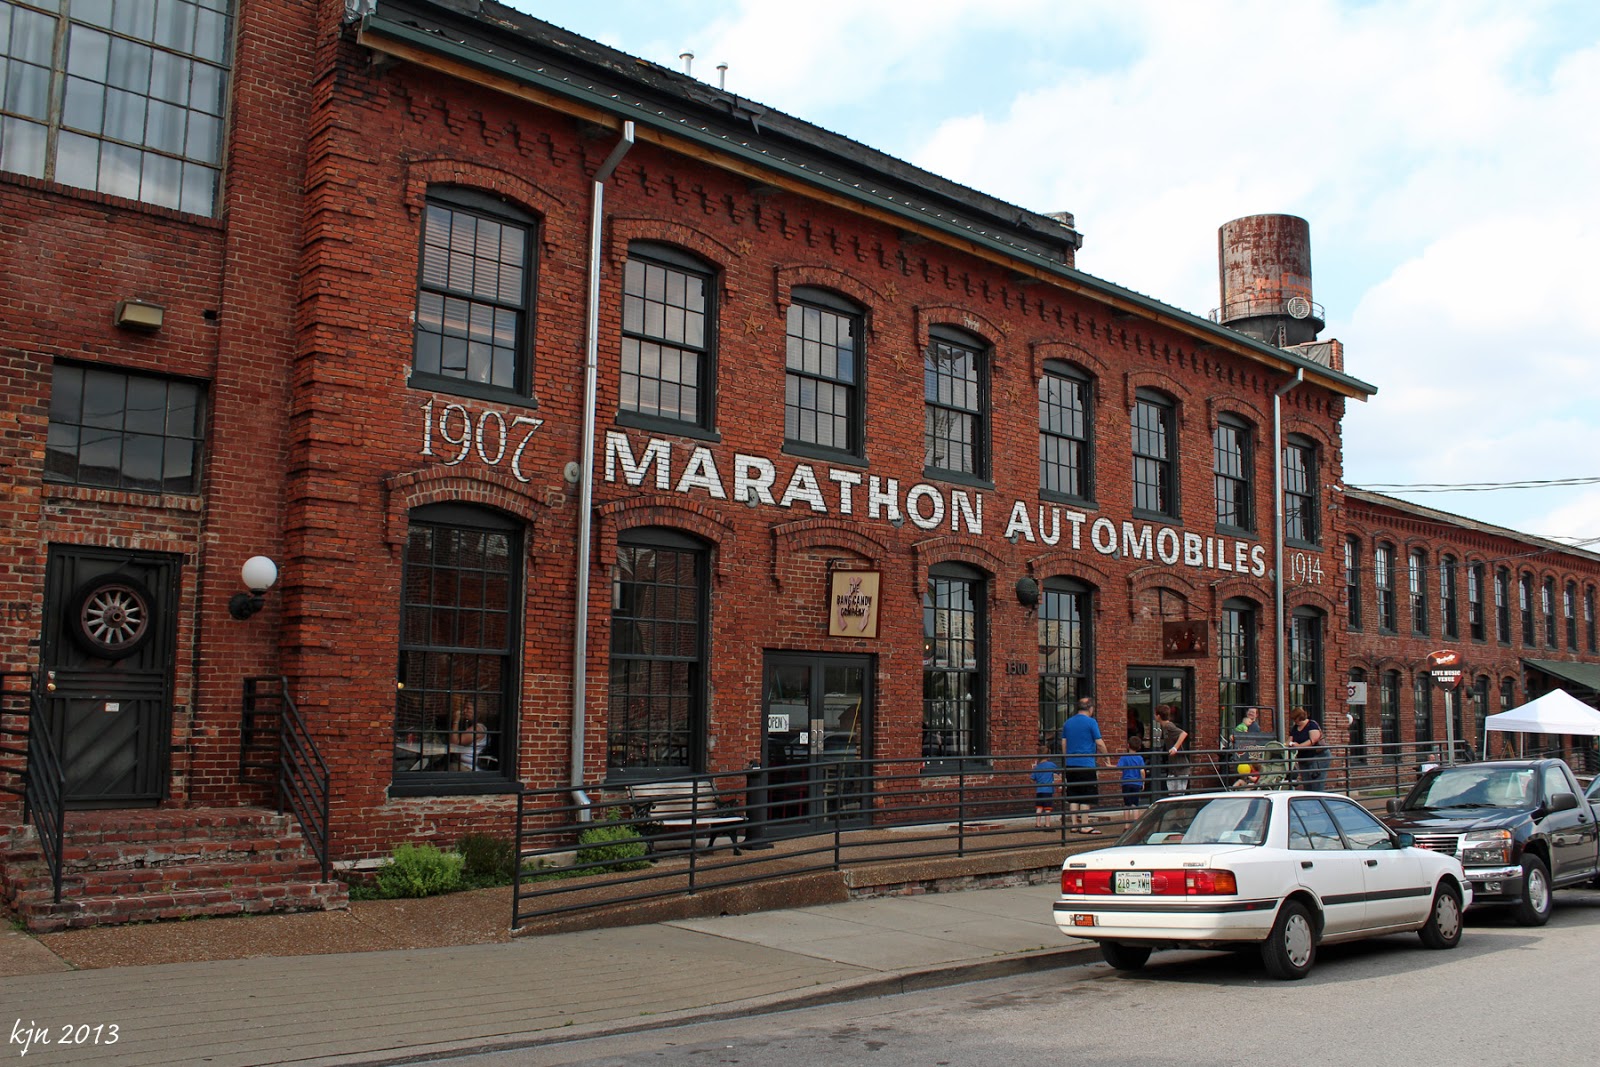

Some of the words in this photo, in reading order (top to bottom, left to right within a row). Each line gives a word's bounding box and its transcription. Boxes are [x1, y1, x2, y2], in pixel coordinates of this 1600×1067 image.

[419, 399, 544, 483] 1907
[603, 429, 983, 536] MARATHON
[1004, 500, 1266, 578] AUTOMOBILES
[1291, 552, 1325, 585] 1914
[836, 594, 852, 606] BANG
[768, 716, 783, 729] OPEN
